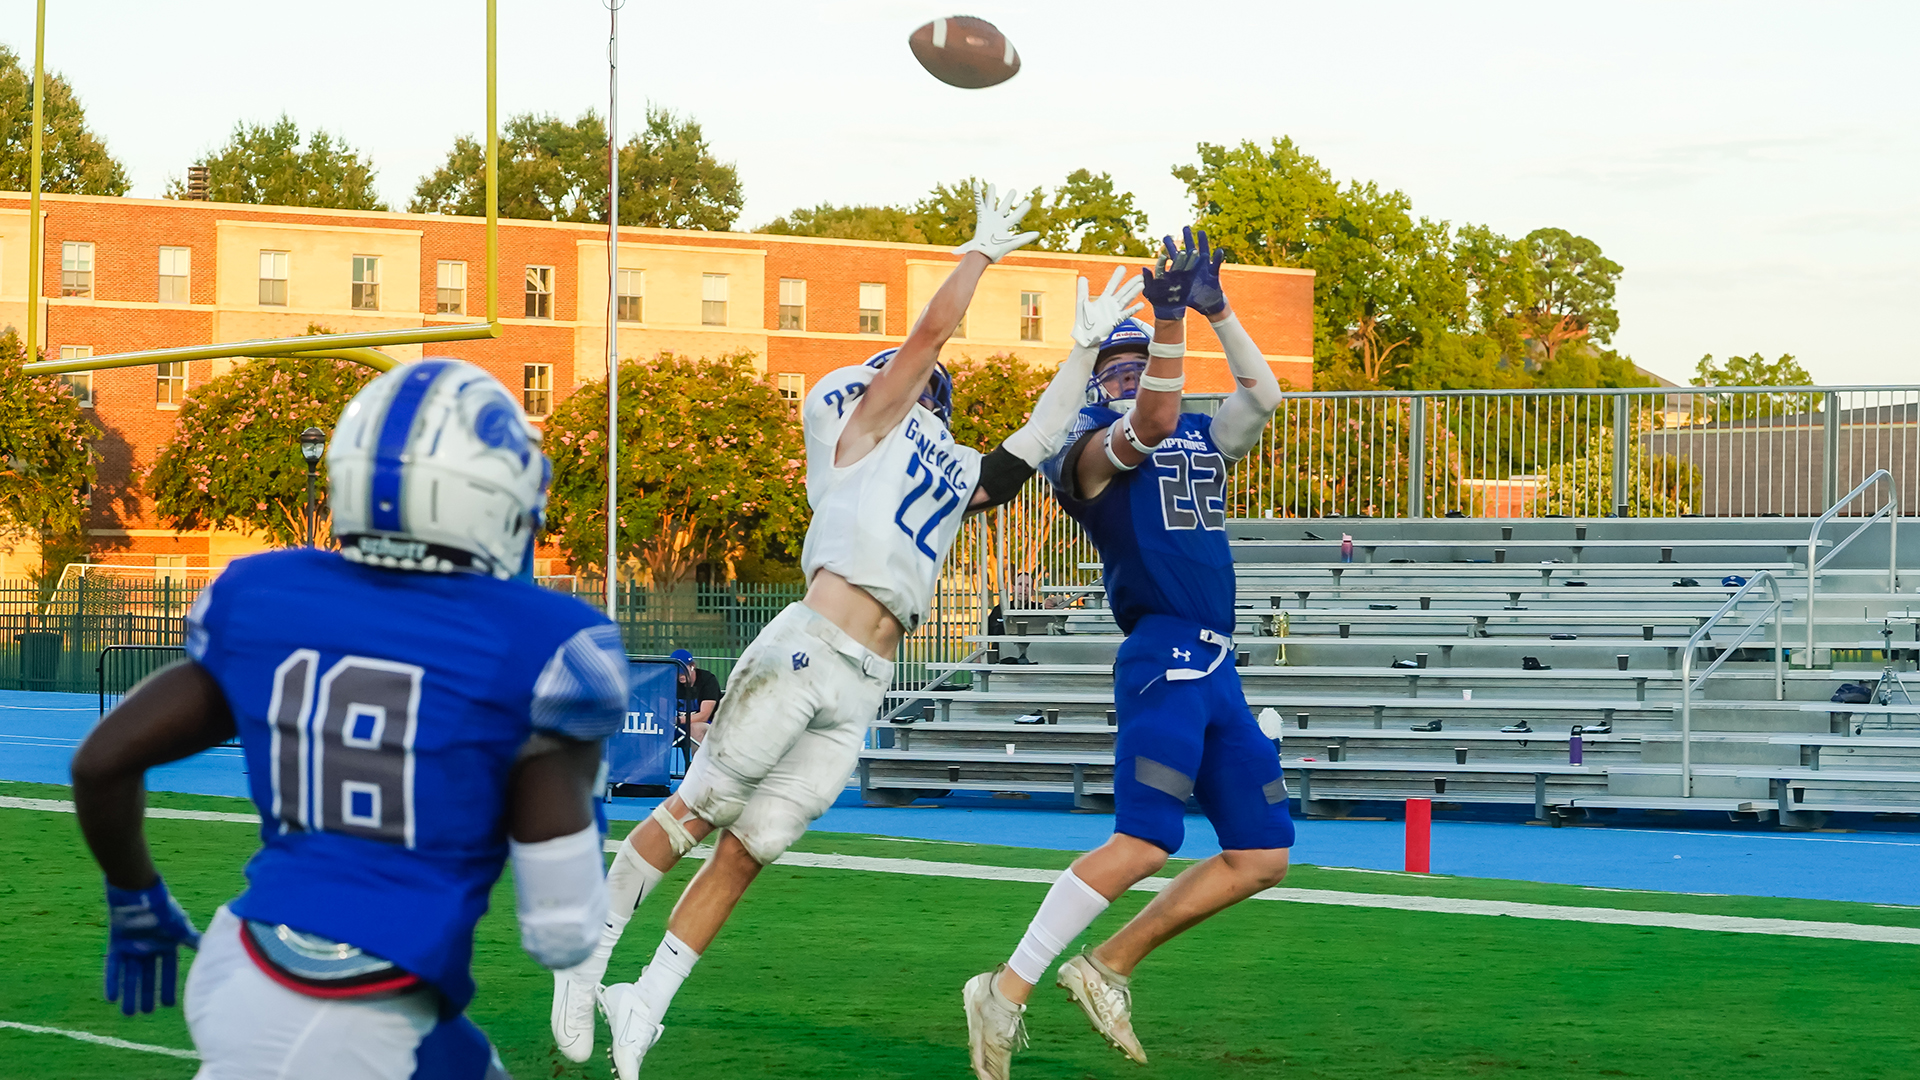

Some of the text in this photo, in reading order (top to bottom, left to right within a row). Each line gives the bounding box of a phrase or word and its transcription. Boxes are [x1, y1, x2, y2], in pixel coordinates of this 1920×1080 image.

[905, 417, 967, 490] GNERALS
[1152, 450, 1226, 531] 22
[895, 451, 960, 562] 22
[267, 648, 425, 850] 18
[622, 711, 664, 735] ILL.
[1087, 980, 1115, 1031] adidas
